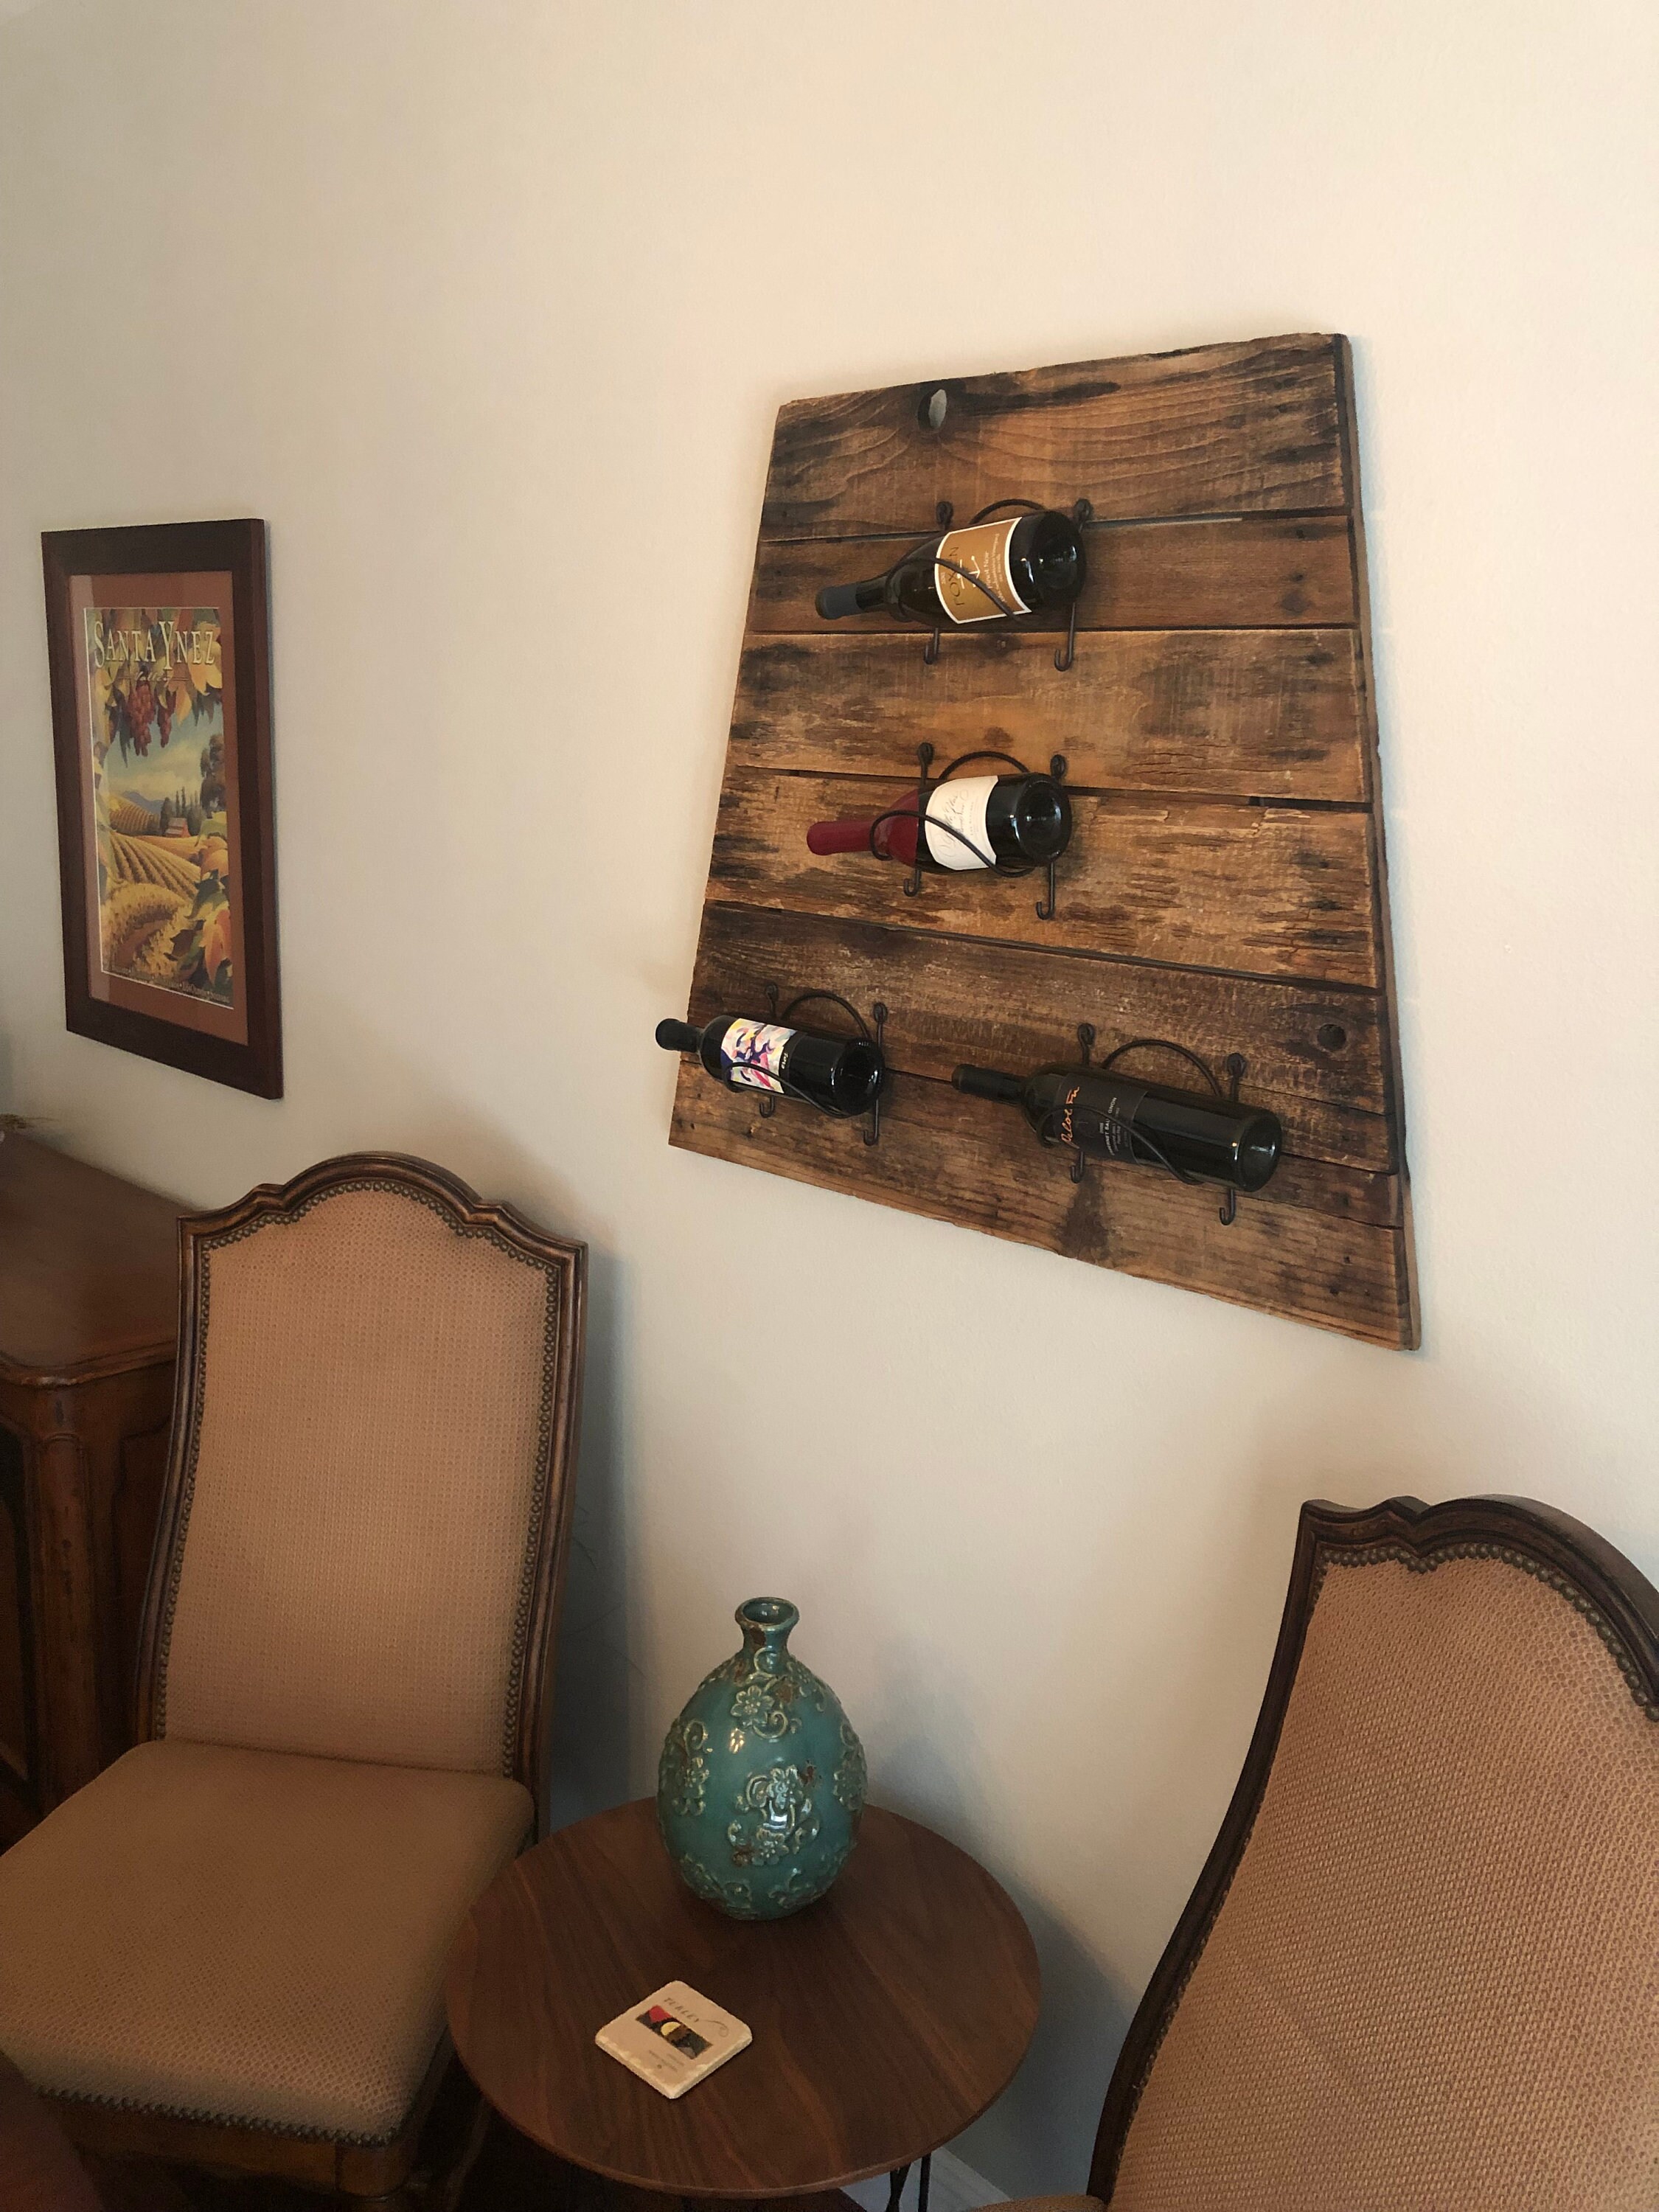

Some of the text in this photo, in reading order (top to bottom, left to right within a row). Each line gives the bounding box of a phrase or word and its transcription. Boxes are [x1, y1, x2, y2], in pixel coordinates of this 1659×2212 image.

[94, 620, 215, 670] SANTA YNEZ
[135, 671, 170, 688] Valley
